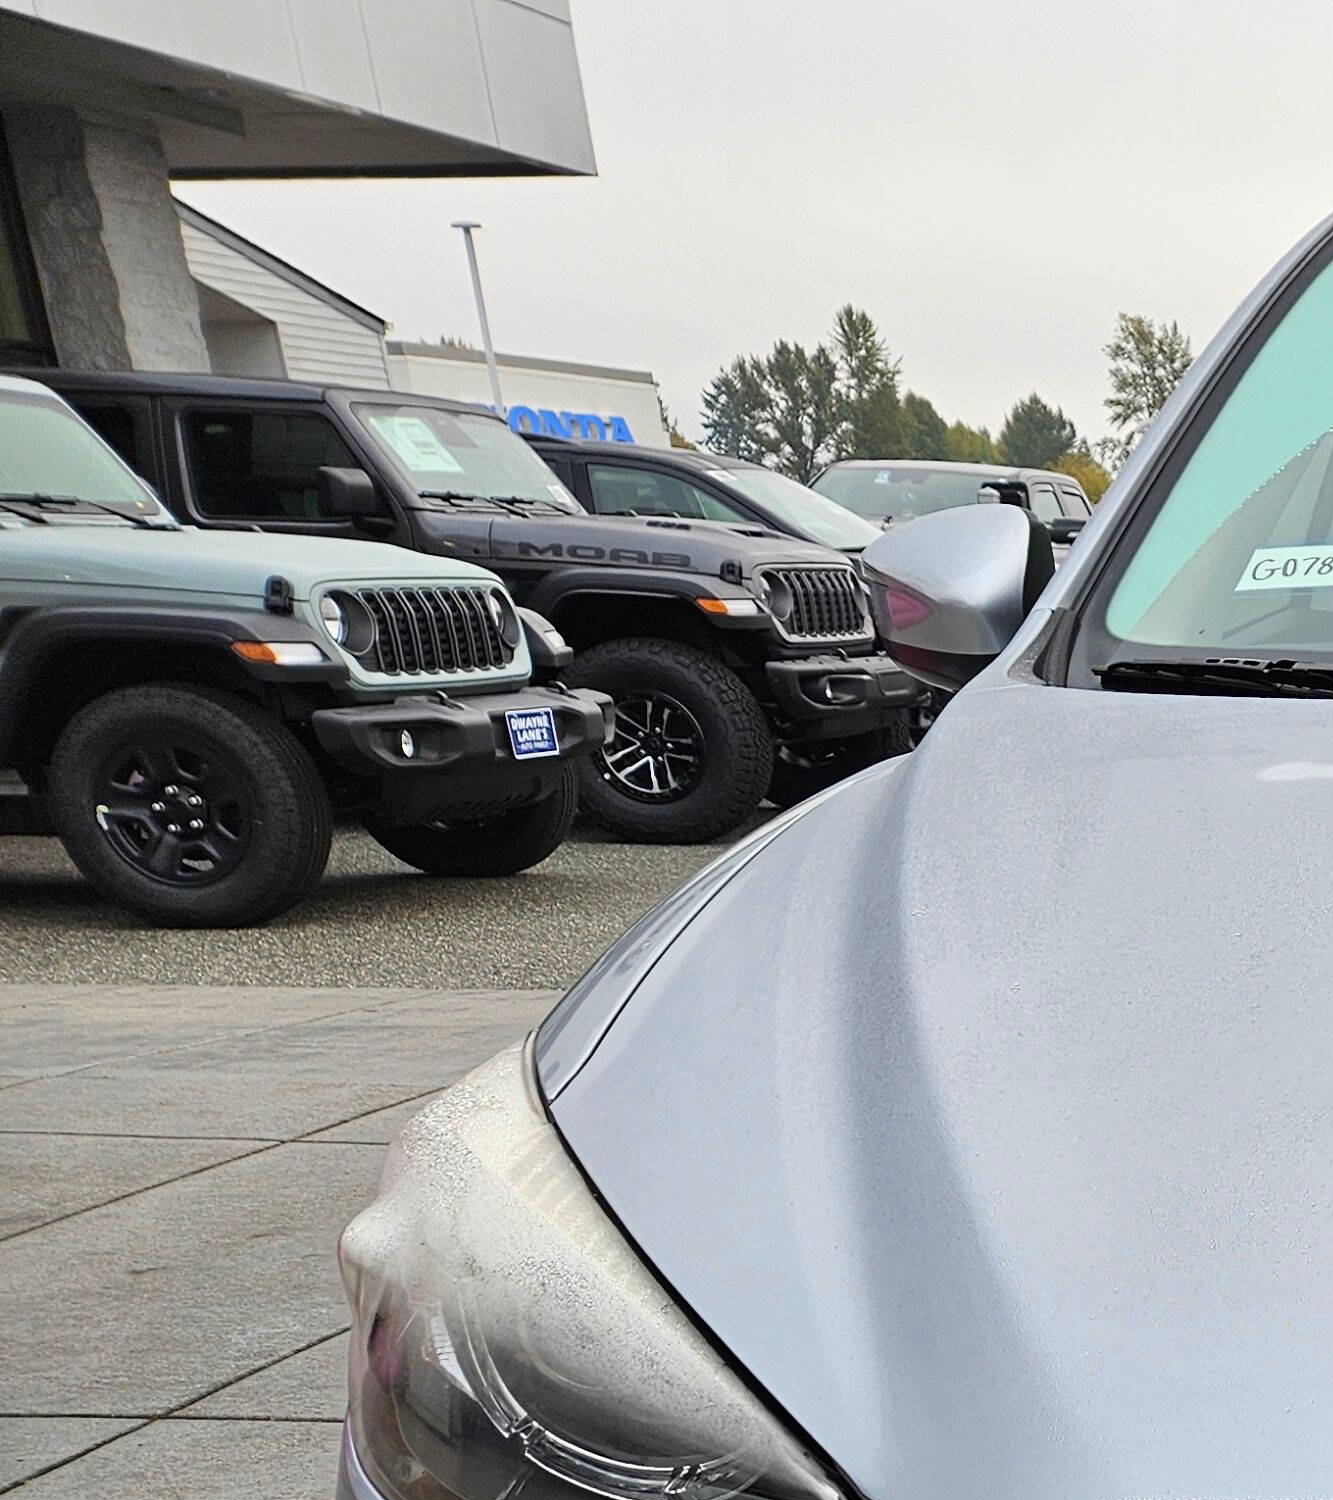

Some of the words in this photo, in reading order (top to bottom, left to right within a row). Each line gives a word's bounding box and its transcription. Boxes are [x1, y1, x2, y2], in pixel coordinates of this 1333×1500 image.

[488, 404, 635, 444] ONDA
[518, 541, 691, 567] MOAB
[510, 714, 550, 731] DWAYNE
[516, 727, 549, 743] LANE'S
